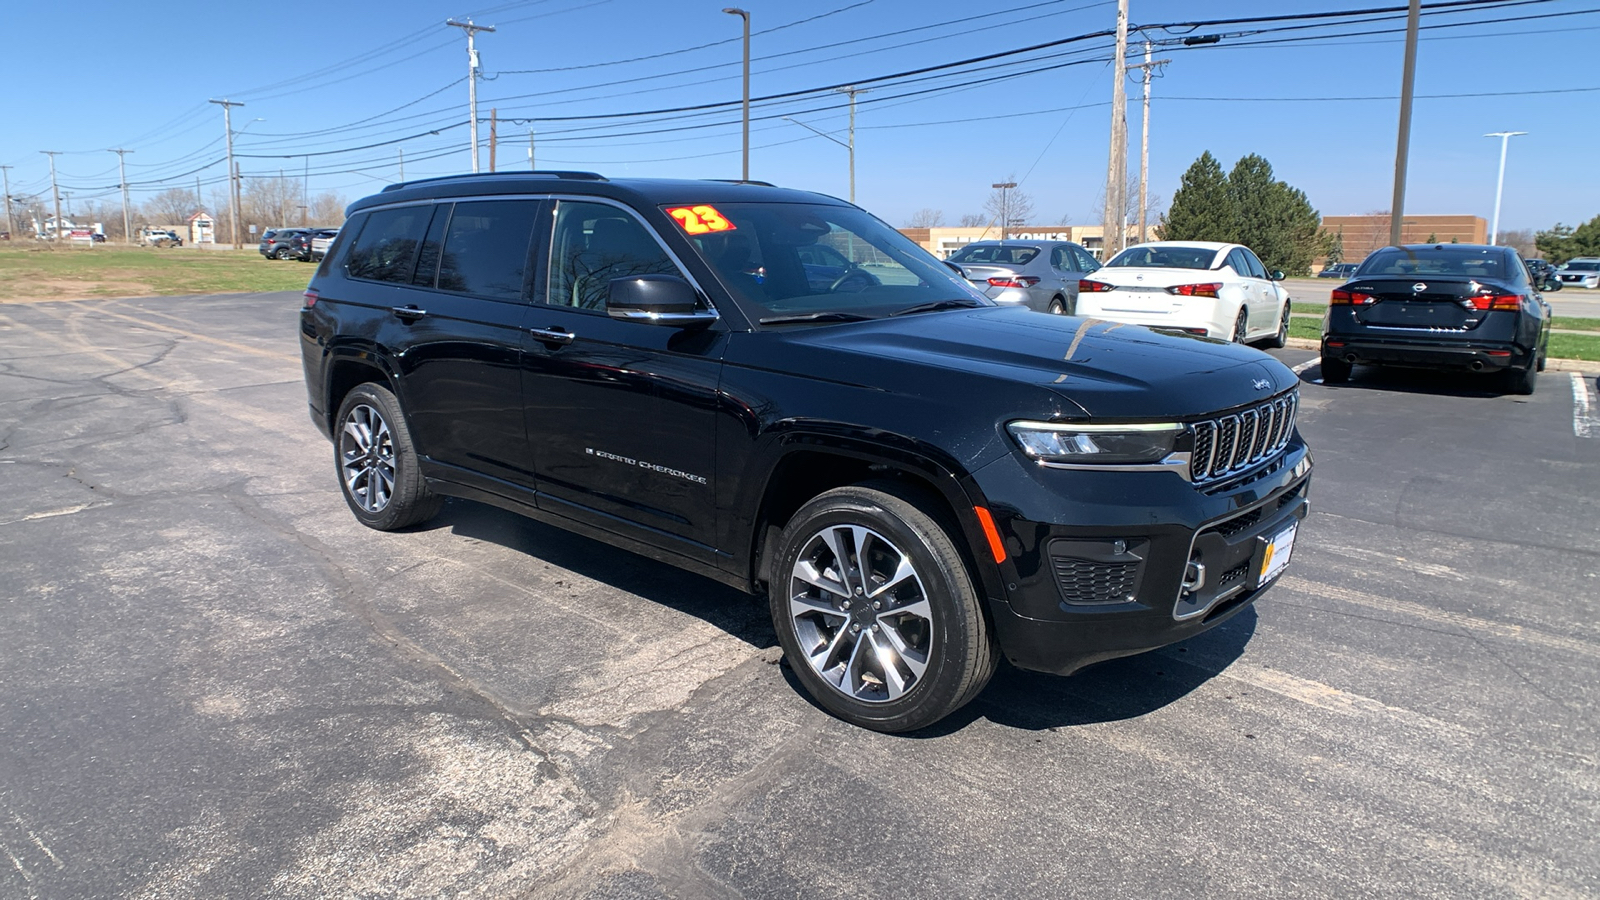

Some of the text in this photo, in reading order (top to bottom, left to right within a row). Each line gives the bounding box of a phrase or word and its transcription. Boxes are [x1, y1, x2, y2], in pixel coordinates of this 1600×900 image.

[671, 205, 729, 233] 23
[596, 450, 707, 485] GRAND CHEROKEE
